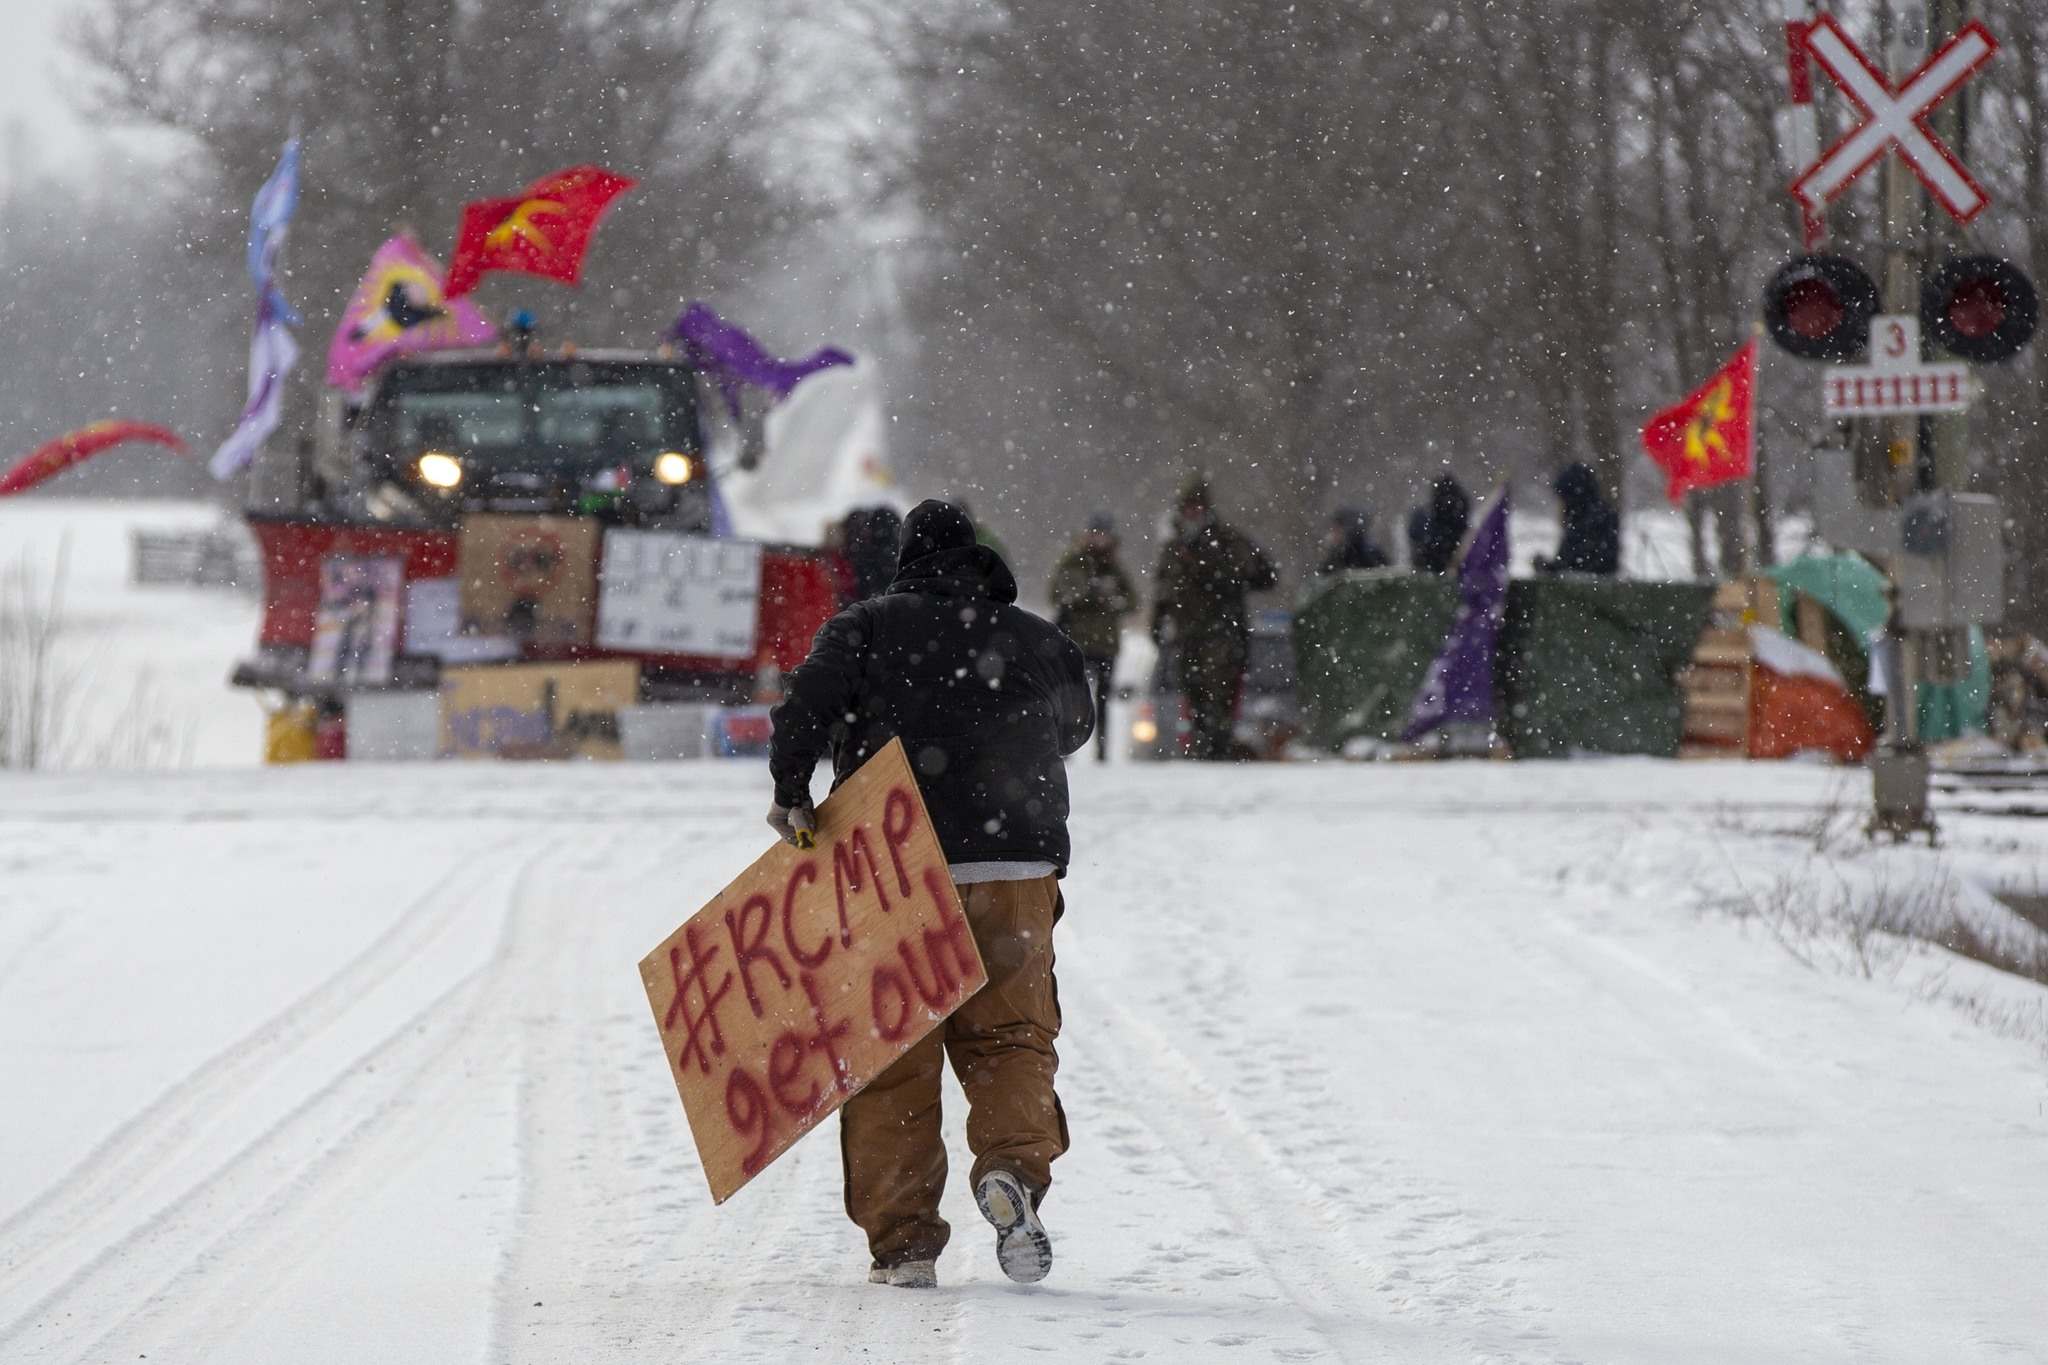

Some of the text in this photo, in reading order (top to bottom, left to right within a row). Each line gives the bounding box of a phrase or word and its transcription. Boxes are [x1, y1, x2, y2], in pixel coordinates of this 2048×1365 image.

[1885, 322, 1906, 357] 3
[665, 788, 916, 1074] #RCMP
[726, 867, 974, 1176] get out
